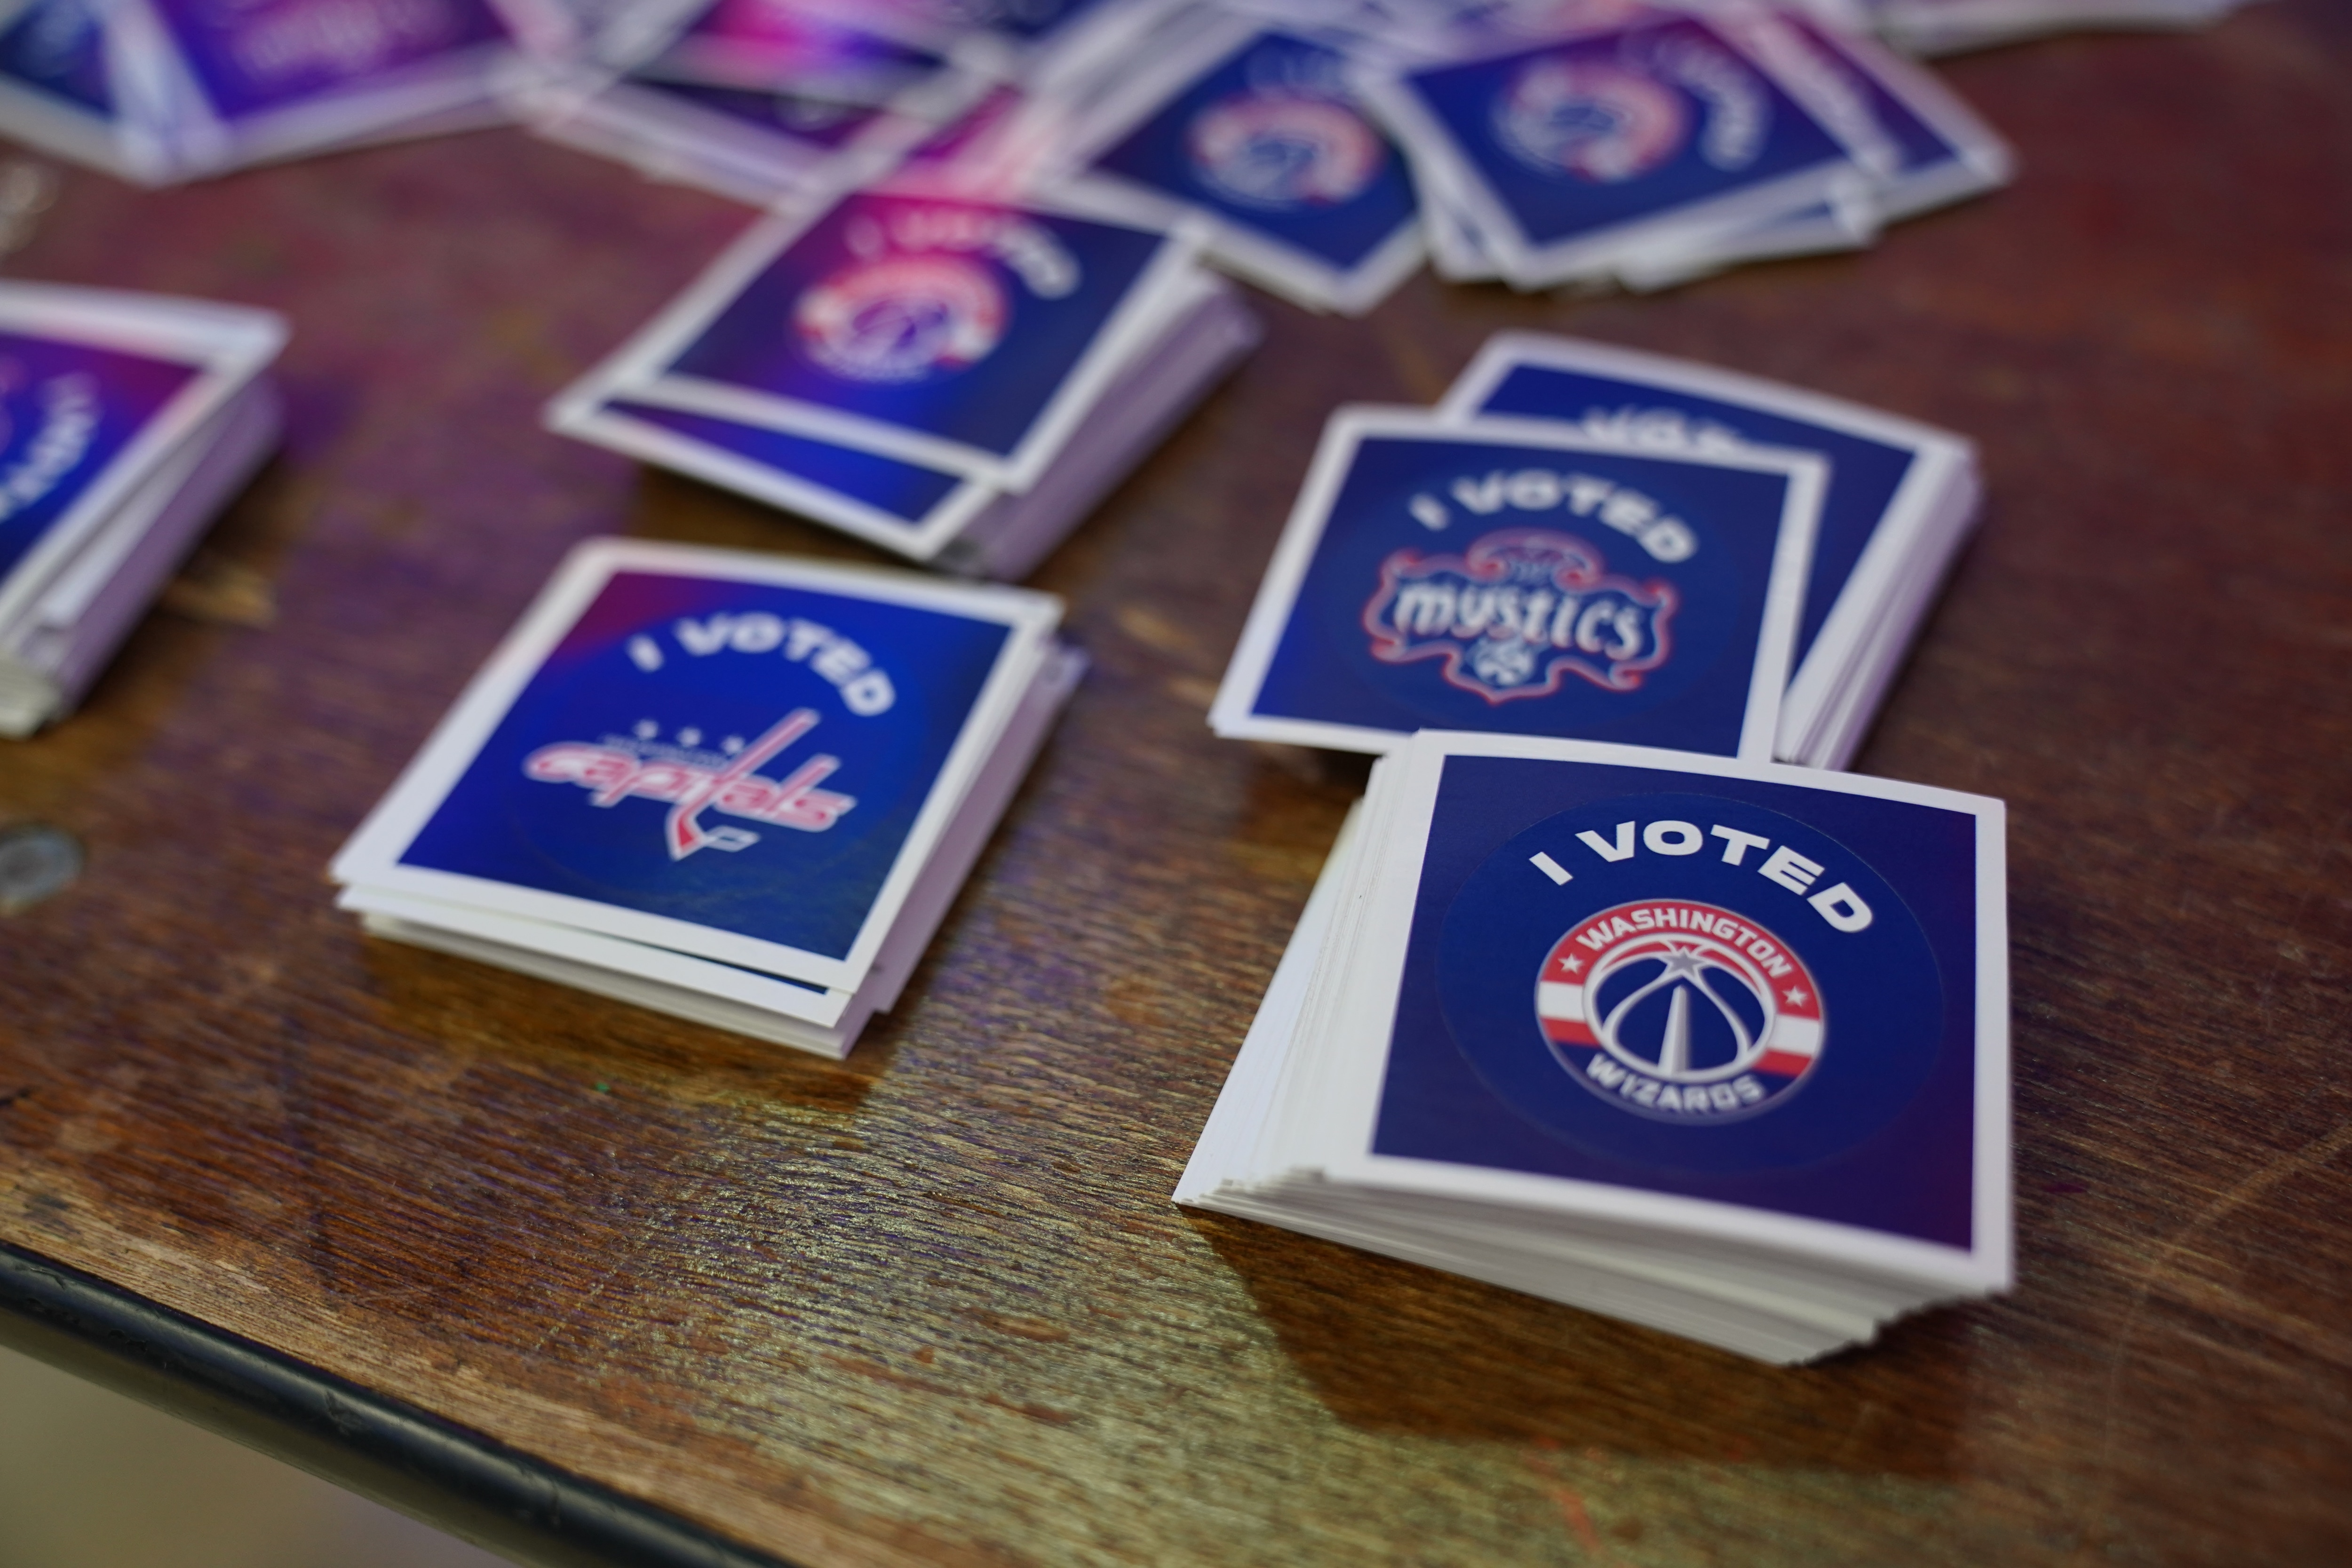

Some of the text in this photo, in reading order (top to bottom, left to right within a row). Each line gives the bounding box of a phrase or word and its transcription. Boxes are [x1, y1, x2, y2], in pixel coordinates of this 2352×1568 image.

[1409, 468, 1697, 563] I VOTED
[627, 612, 896, 716] I VOTED
[1529, 820, 1874, 933] I VOTED
[1576, 907, 1792, 979] WASHINGTON
[1586, 1053, 1766, 1112] WIZARDS
